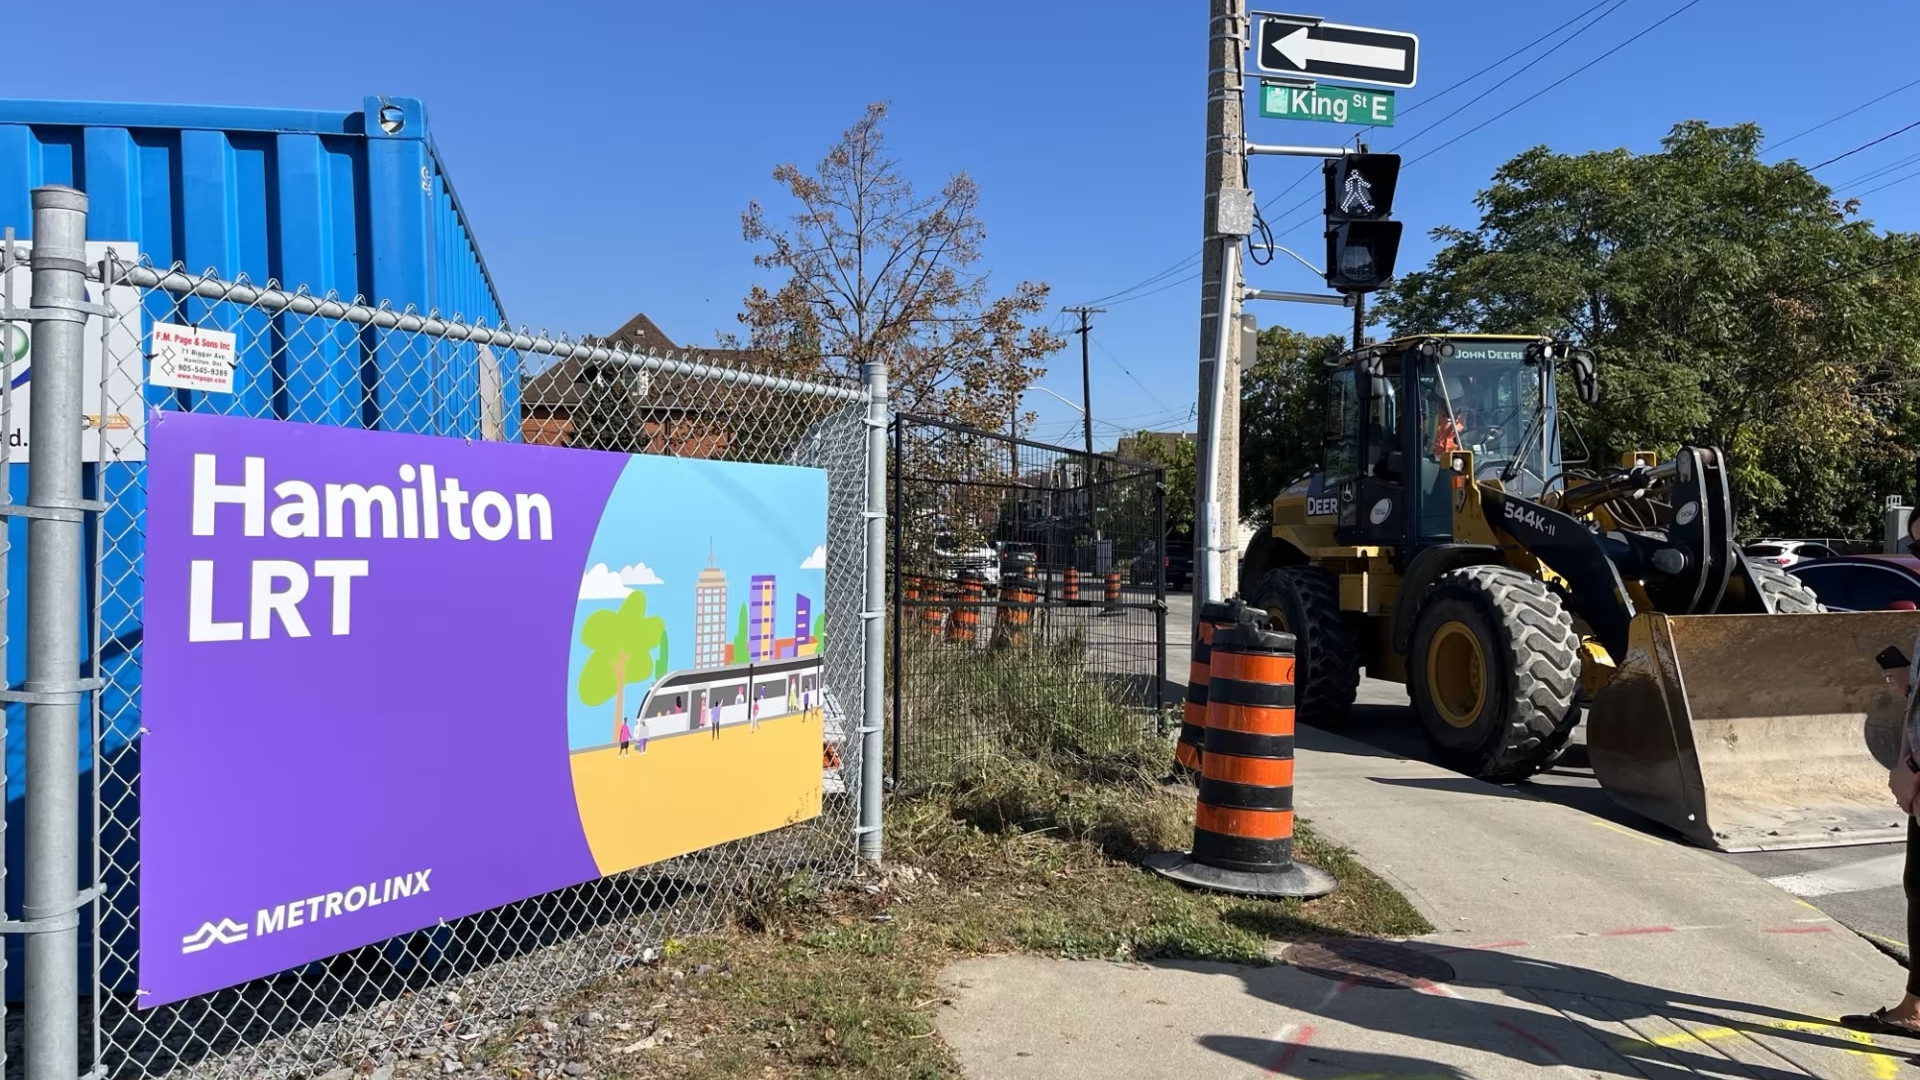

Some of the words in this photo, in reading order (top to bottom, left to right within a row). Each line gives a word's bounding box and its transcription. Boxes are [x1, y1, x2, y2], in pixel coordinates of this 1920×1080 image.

[1291, 90, 1348, 122] King
[1352, 94, 1367, 108] St
[1372, 96, 1388, 120] E
[156, 331, 172, 342] F.M.
[175, 334, 192, 346] Page
[194, 337, 200, 346] &
[201, 338, 219, 349] Sons
[220, 341, 230, 350] Inc
[191, 349, 212, 358] Biggar
[1455, 349, 1486, 360] JOHN
[1487, 350, 1524, 360] DEERE
[178, 363, 228, 377] 905-545-9389
[192, 453, 553, 541] Hamilton
[1307, 497, 1339, 515] DEER
[188, 559, 369, 642] LRT
[256, 868, 432, 937] METROLINX
